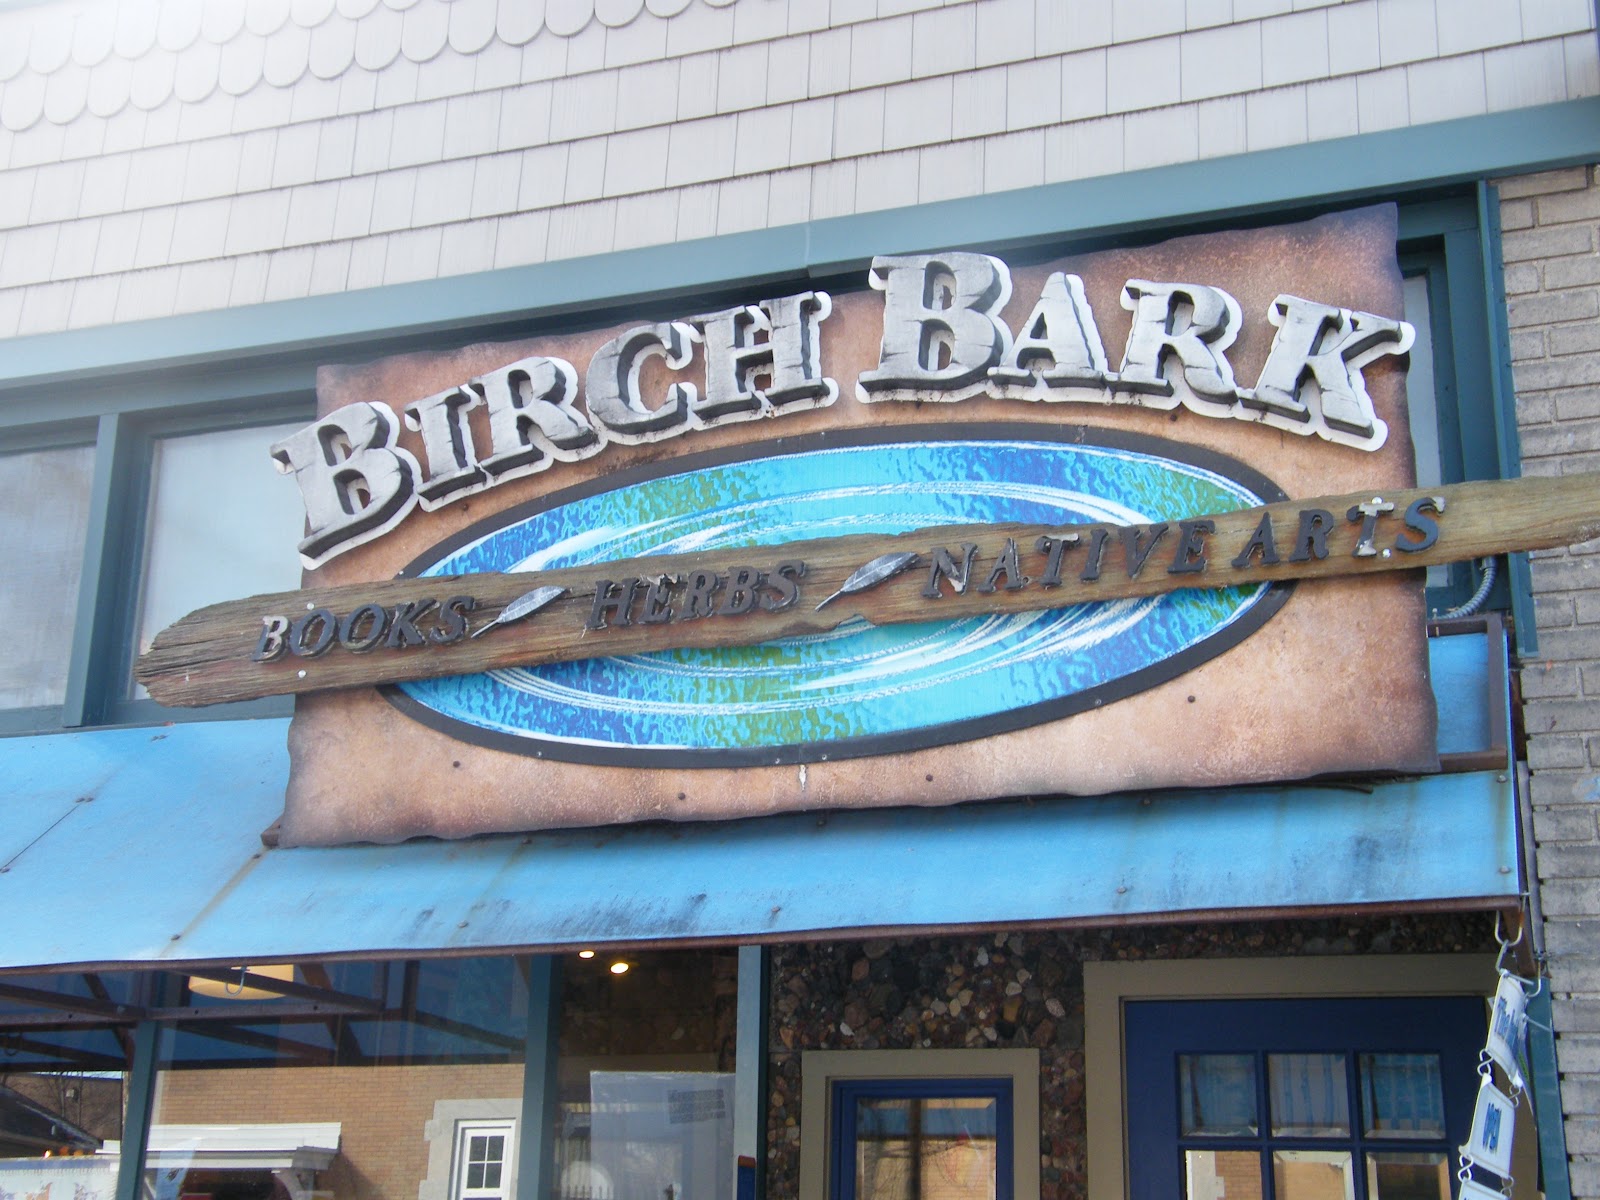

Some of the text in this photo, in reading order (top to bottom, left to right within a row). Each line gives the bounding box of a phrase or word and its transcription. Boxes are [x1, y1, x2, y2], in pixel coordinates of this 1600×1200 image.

[270, 252, 1415, 569] BIRCH BARK
[252, 496, 1445, 662] BOOKS HERBS NATIVE ARTS
